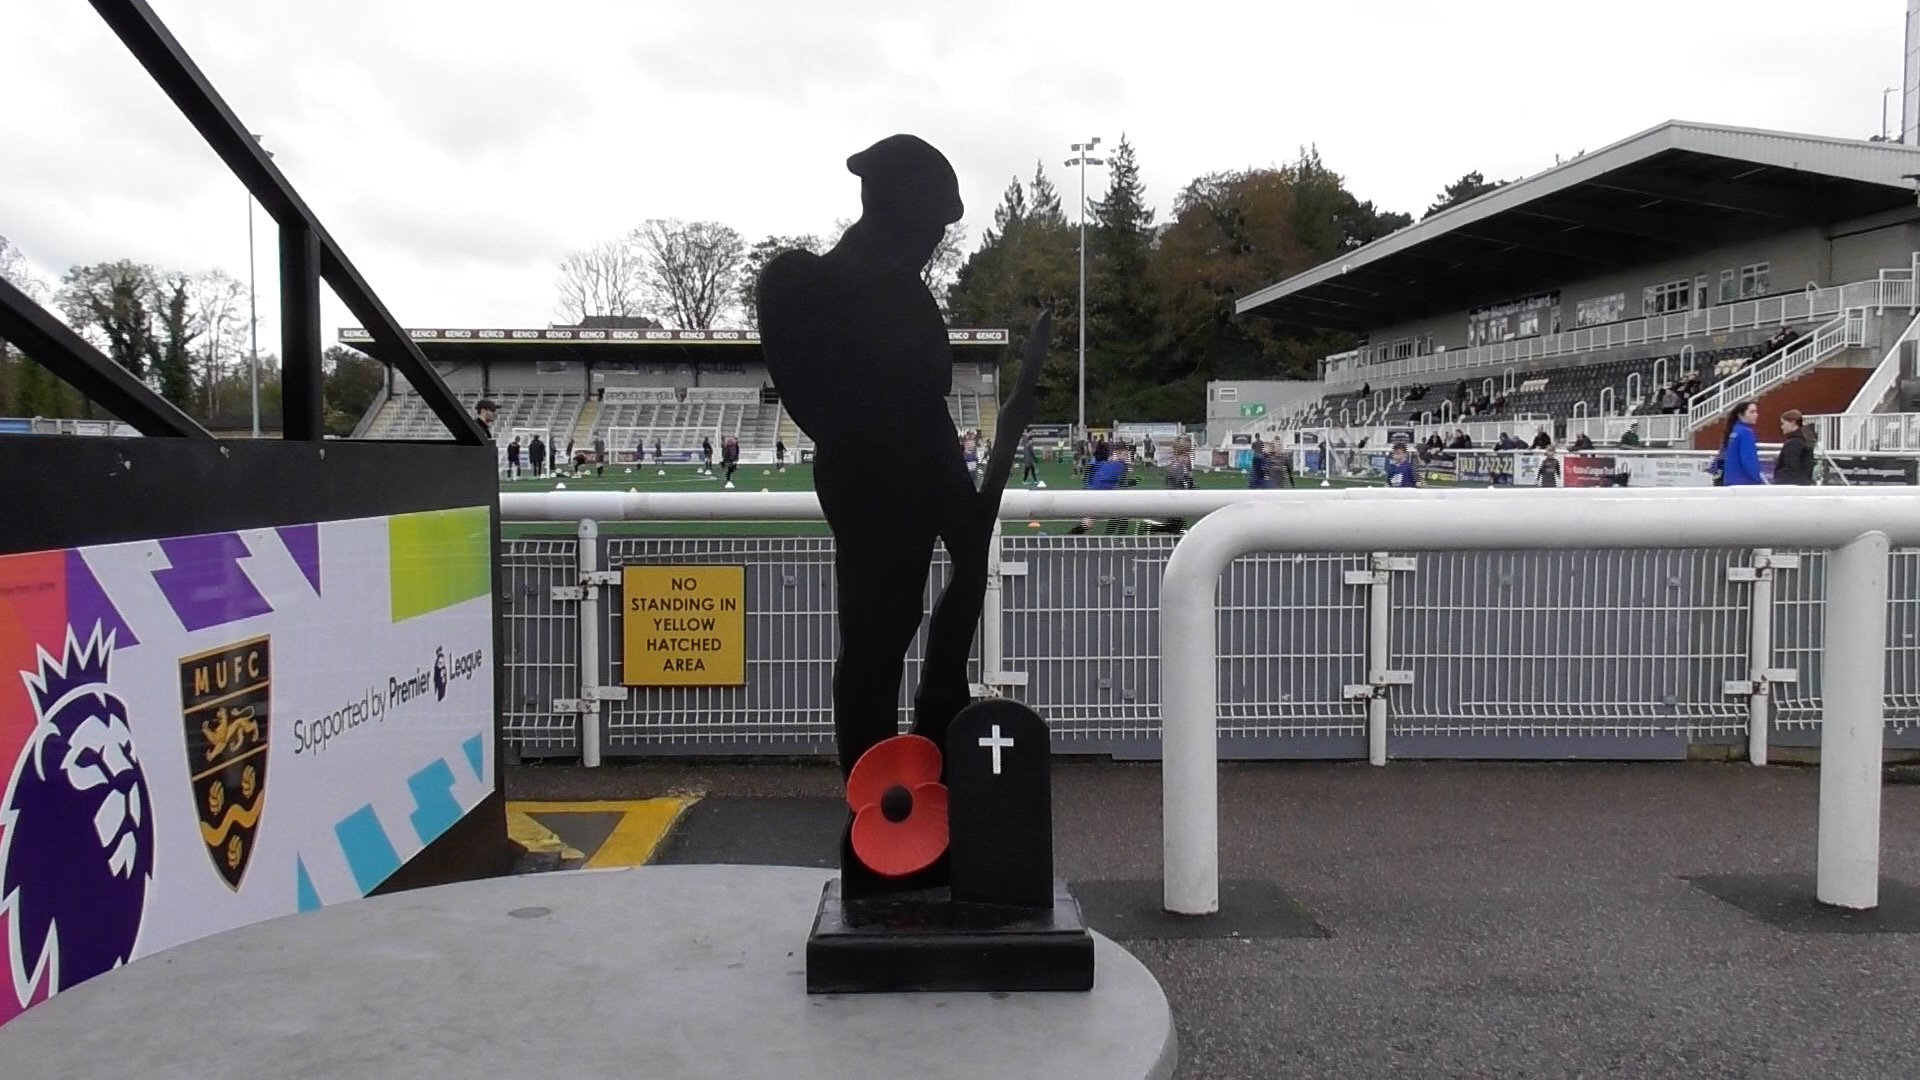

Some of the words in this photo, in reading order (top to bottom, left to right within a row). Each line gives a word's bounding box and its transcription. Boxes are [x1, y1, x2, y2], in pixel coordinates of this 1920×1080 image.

[671, 577, 697, 591] NO
[631, 597, 715, 612] STANDING
[720, 597, 737, 611] IN
[653, 618, 716, 632] YELLOW
[646, 638, 722, 652] HATCHED
[663, 658, 706, 672] AREA
[194, 651, 260, 696] MUFC
[294, 686, 369, 757] Supported
[371, 685, 387, 723] by
[389, 667, 431, 709] Premier
[449, 649, 483, 681] League
